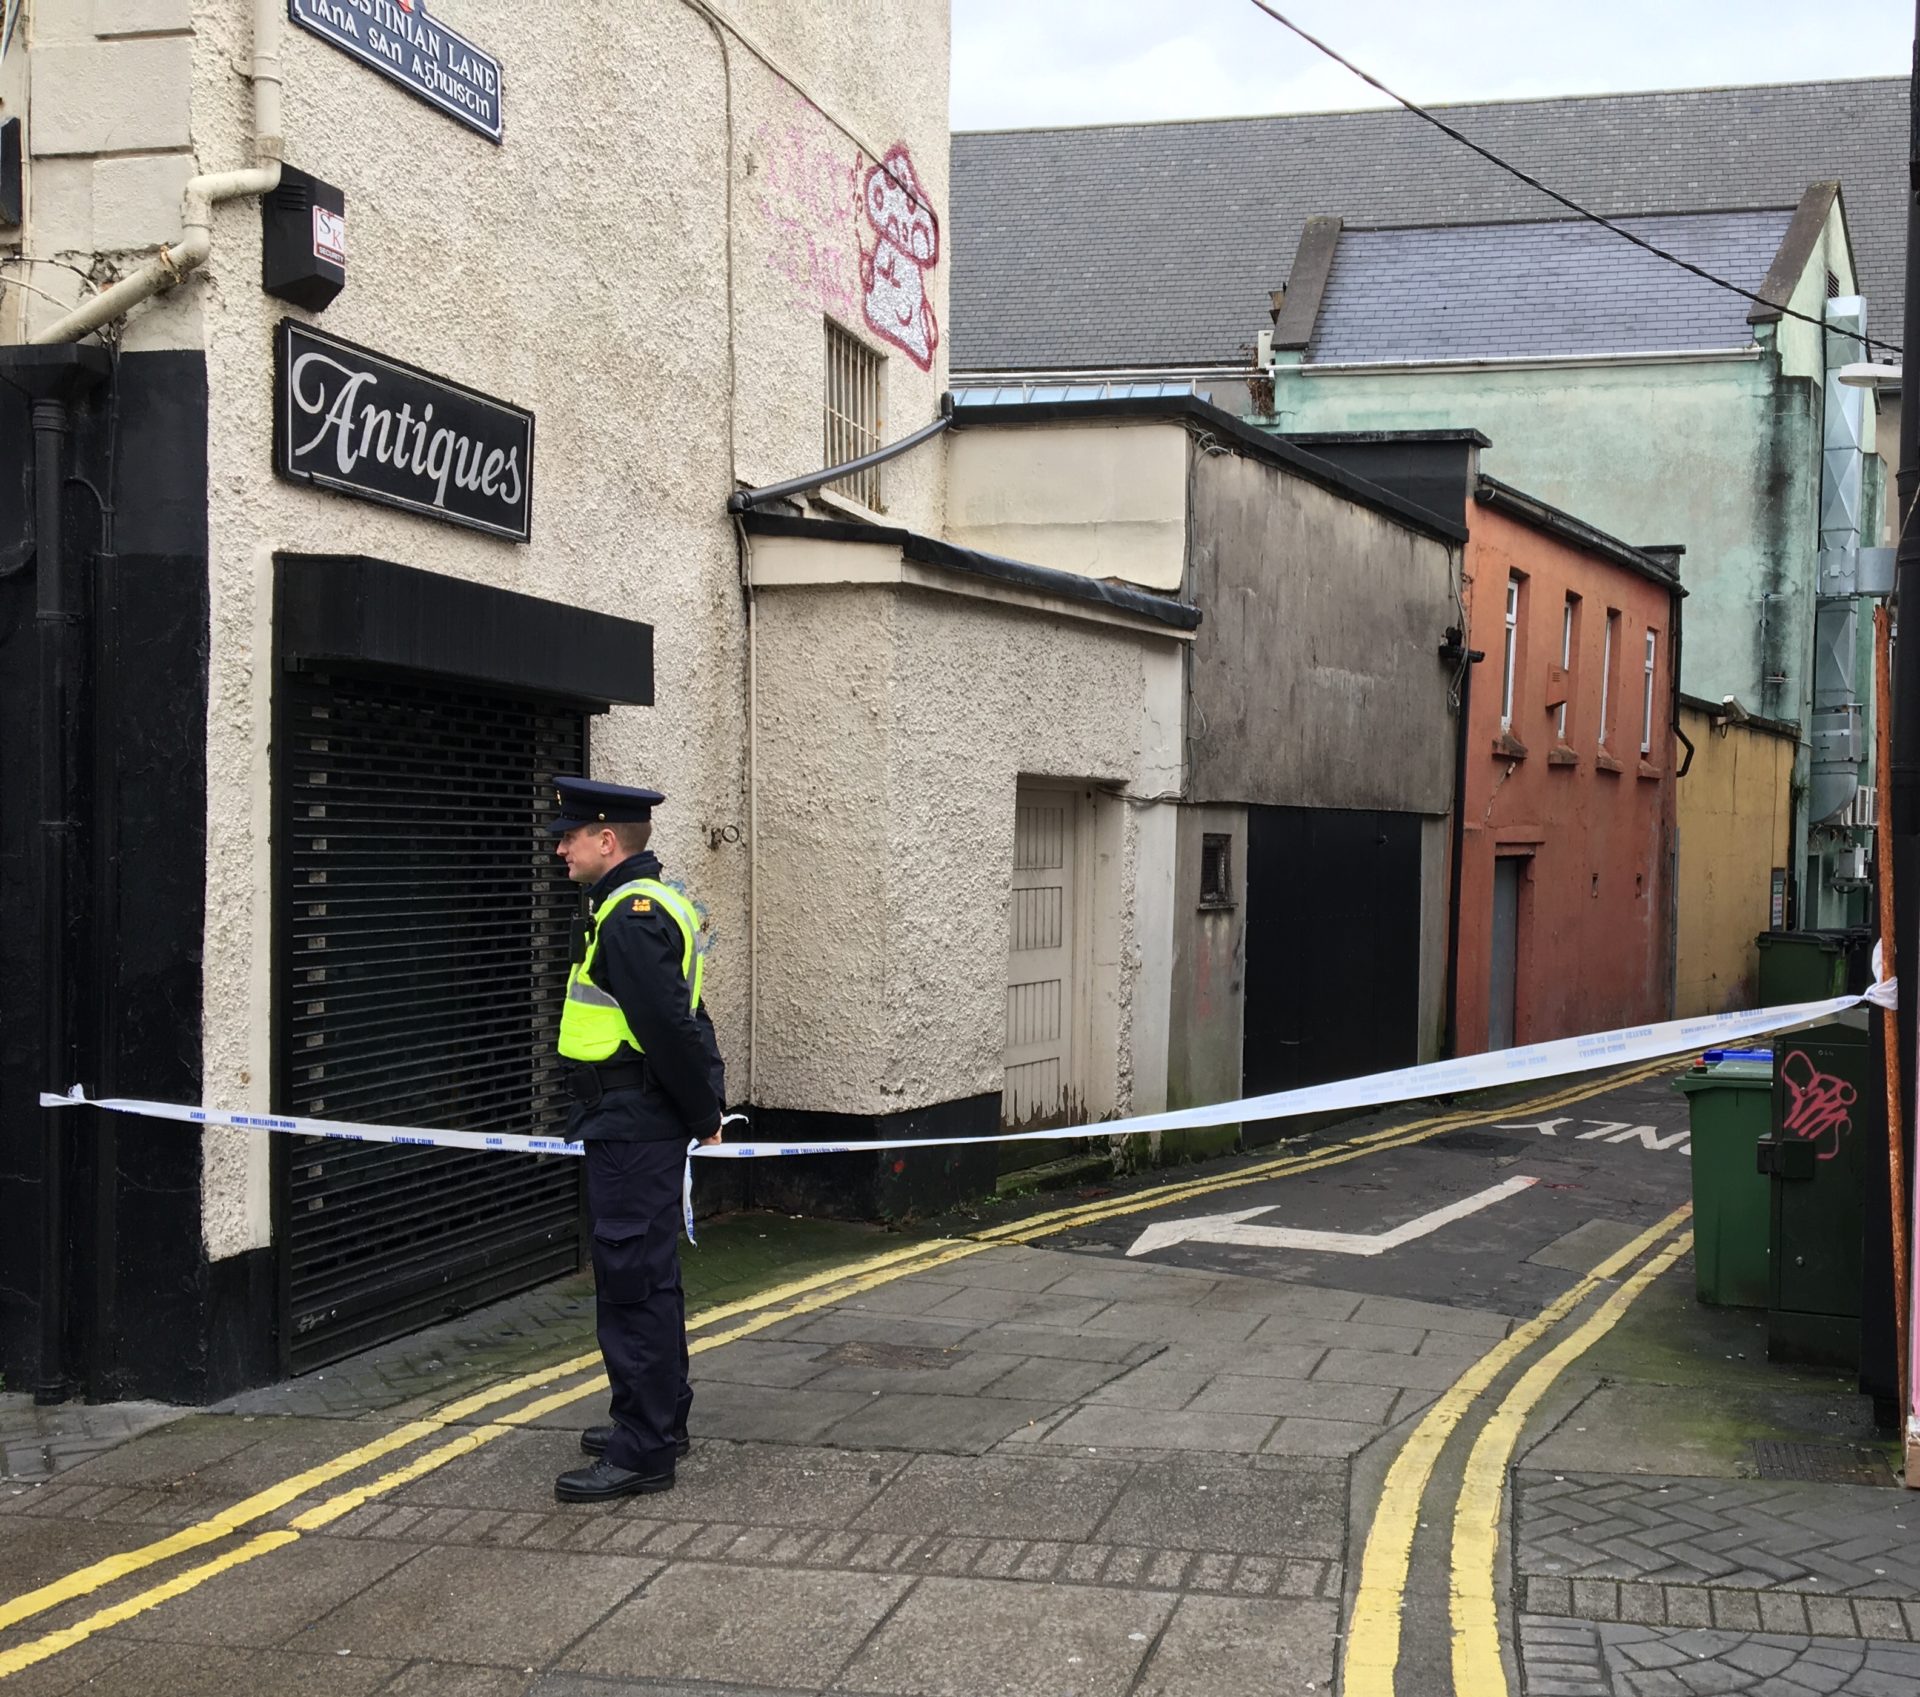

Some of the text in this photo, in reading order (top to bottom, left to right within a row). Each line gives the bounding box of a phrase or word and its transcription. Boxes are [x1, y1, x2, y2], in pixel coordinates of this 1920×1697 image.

[447, 42, 497, 96] LANE
[319, 246, 344, 263] SECURITY
[291, 352, 522, 507] Antiques
[190, 1111, 206, 1120] GARDA
